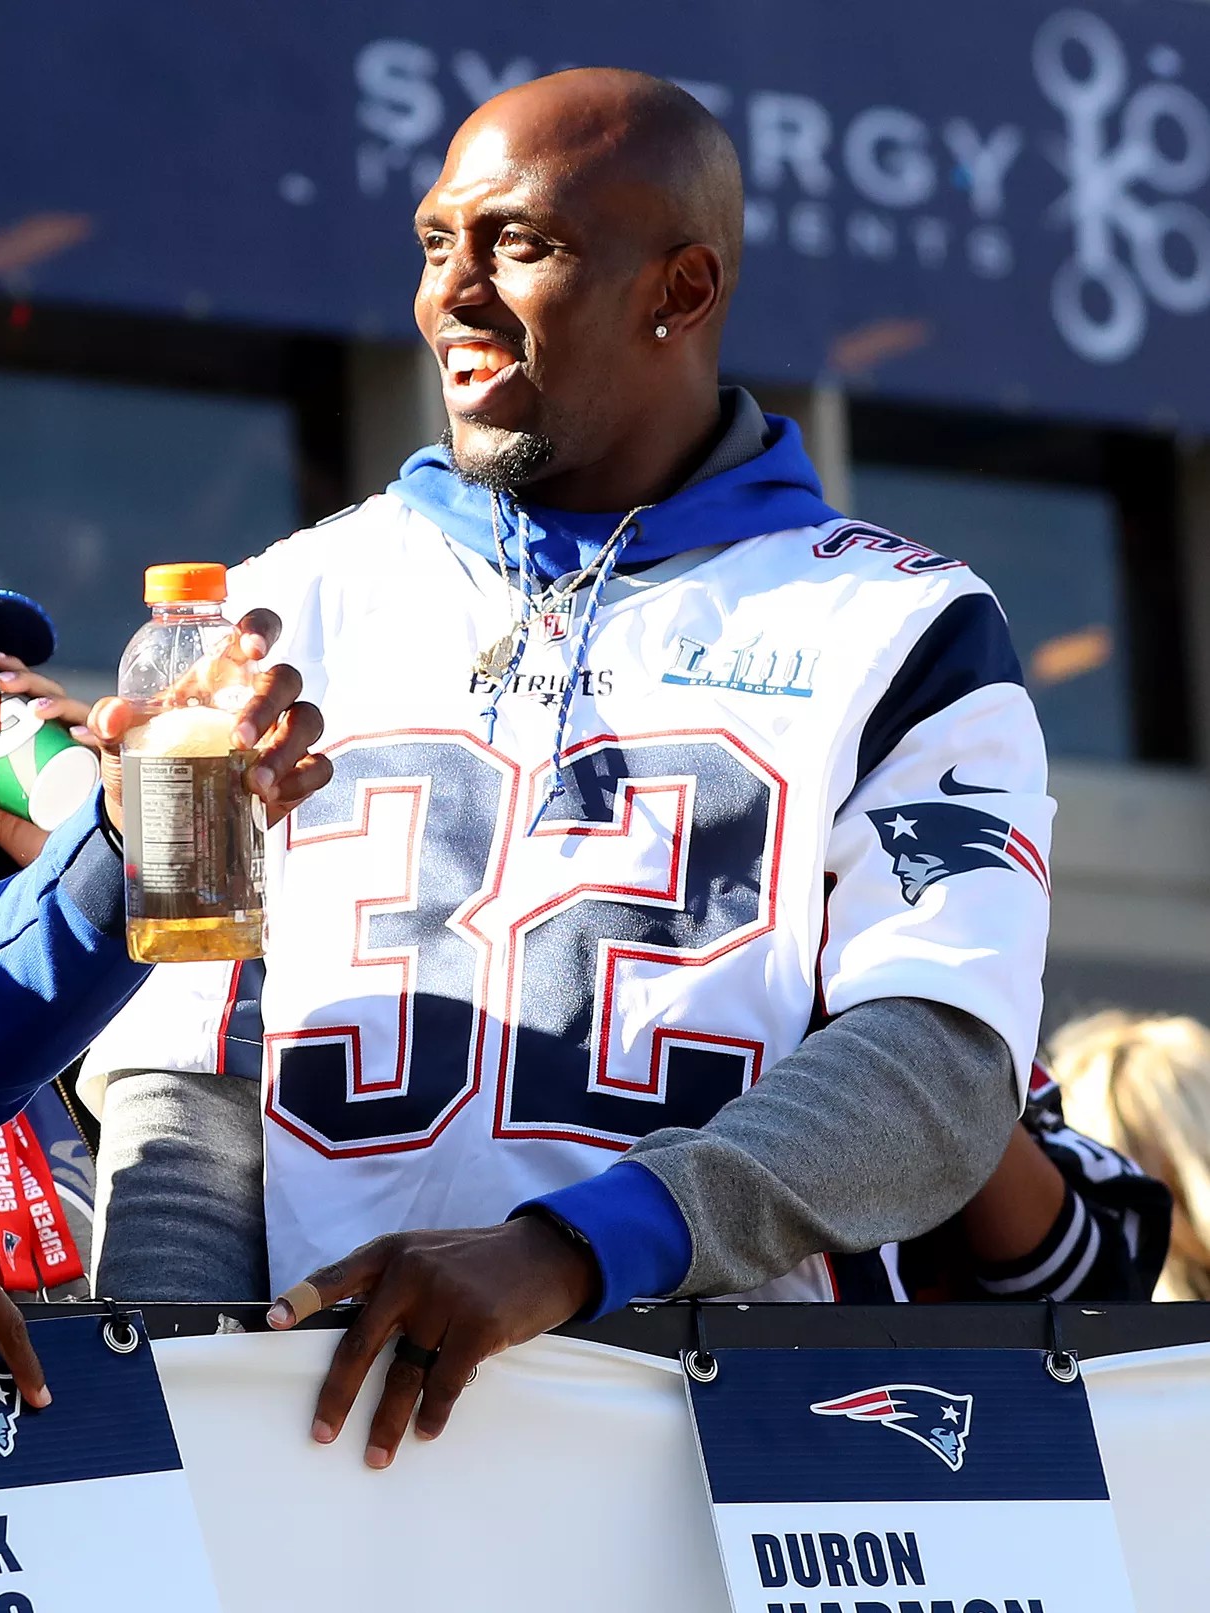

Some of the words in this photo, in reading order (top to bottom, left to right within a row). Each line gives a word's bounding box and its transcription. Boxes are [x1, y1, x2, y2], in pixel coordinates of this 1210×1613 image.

[689, 678, 739, 690] SUPER
[744, 683, 785, 695] BOWL
[264, 727, 788, 1160] 32
[29, 1200, 68, 1267] SUPER
[750, 1530, 927, 1589] DURON
